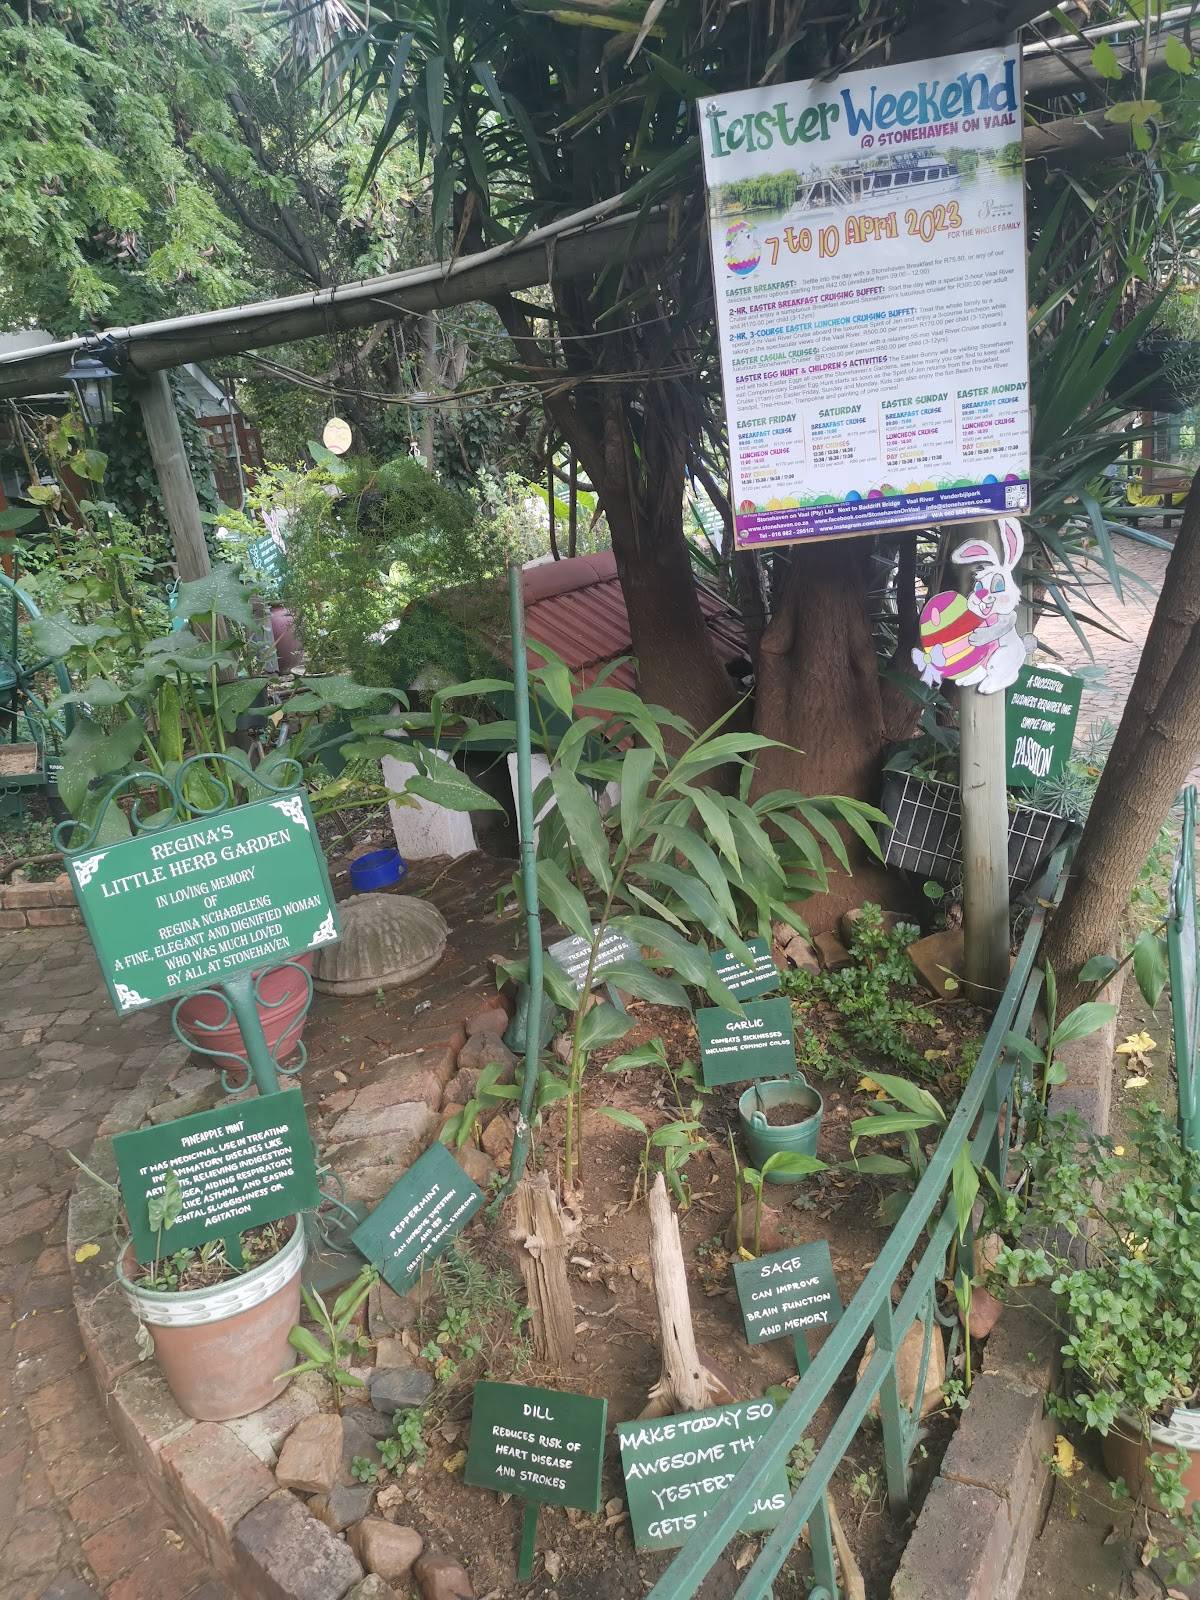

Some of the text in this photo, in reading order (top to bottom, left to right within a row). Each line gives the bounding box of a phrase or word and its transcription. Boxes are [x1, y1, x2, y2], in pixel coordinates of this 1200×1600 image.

[705, 58, 1018, 158] Easter Weekend
[860, 112, 1016, 149] @ STONEHAVEN ON VAAL
[765, 237, 780, 265] 7
[783, 226, 813, 254] to
[818, 225, 840, 258] 10
[844, 211, 898, 245] April
[904, 200, 963, 243] 2023
[947, 220, 1021, 240] FOR THE WHOLE FAMILY
[725, 279, 797, 297] EASTER BREAKFAST:
[749, 302, 777, 313] EASTER
[778, 295, 818, 309] BREAKFAST
[820, 290, 854, 302] CRUISING
[856, 285, 885, 297] BUFFET:
[749, 326, 784, 339] 3-COURSE
[785, 322, 813, 333] EASTER
[814, 316, 851, 329] LUNCHEON
[853, 311, 886, 323] CRUISING
[732, 356, 758, 366] EASTER
[760, 351, 786, 362] CASUAL
[735, 373, 762, 384] EASTER
[763, 371, 779, 380] EGG
[780, 367, 799, 377] HUNT
[849, 354, 888, 368] ACTIVITIES
[881, 392, 949, 410] EASTER SUNDAY
[957, 381, 1027, 399] EASTER MONDAY
[737, 413, 797, 429] EASTER FRIDAY
[818, 404, 862, 418] SATURDAY
[756, 513, 789, 524] Stonehaven
[919, 495, 934, 503] River
[1011, 735, 1055, 778] PASSION
[152, 825, 233, 860] REGINA'S
[101, 829, 290, 897] LITTLE HERB GARDEN
[156, 866, 255, 908] IN LOVING MEMORY
[204, 894, 217, 908] OF
[159, 895, 271, 939] REGINA NCHABELENG
[115, 895, 321, 971] A FINE, ELEGANT AND DIGNIFIED WOMAN
[165, 924, 282, 970] WHO WAS MUCH LOVED
[167, 937, 290, 986] BY ALL AT STONEHAVEN
[568, 947, 592, 961] TREATS
[711, 1031, 782, 1044] COMBATS SICKNESSES
[726, 1019, 763, 1031] GARLIC
[705, 1046, 738, 1054] INCLUDING
[740, 1042, 767, 1050] COMMON
[181, 1121, 244, 1147] PINEAPPLE MINT
[139, 1125, 288, 1175] IT HAS MEDICINAL USE IN TREATING
[152, 1137, 283, 1184] INFAMMATORY DISEASES LIKE
[193, 1146, 292, 1182] RELIEVING INDIGESTION
[205, 1175, 235, 1190] AIDING
[236, 1158, 292, 1180] RESPIRATORY
[182, 1168, 294, 1210] LIKE ASTHMA AND EASING
[207, 1183, 284, 1213] SLUGGISHNESS OR
[205, 1205, 251, 1227] AGITATION
[390, 1184, 439, 1239] PEPPERMINT
[394, 1243, 406, 1257] CAN
[406, 1218, 430, 1244] IMPROVE
[420, 1229, 432, 1243] AND
[431, 1224, 451, 1243] BOWEL
[761, 1257, 801, 1277] SAGE
[752, 1277, 819, 1300] CAN IMPROVE
[746, 1293, 830, 1321] BRAIN FUNCTION
[759, 1311, 827, 1336] AND MEMORY
[523, 1404, 554, 1420] DILL
[493, 1426, 581, 1452] REDUCES RISK OF
[619, 1403, 773, 1451] MAKE TODAY SO
[496, 1444, 572, 1469] HEART DISEASE
[625, 1444, 725, 1480] AWESOME
[496, 1465, 565, 1489] AND STROKES
[651, 1473, 736, 1510] YESTER
[647, 1518, 697, 1538] GETS
